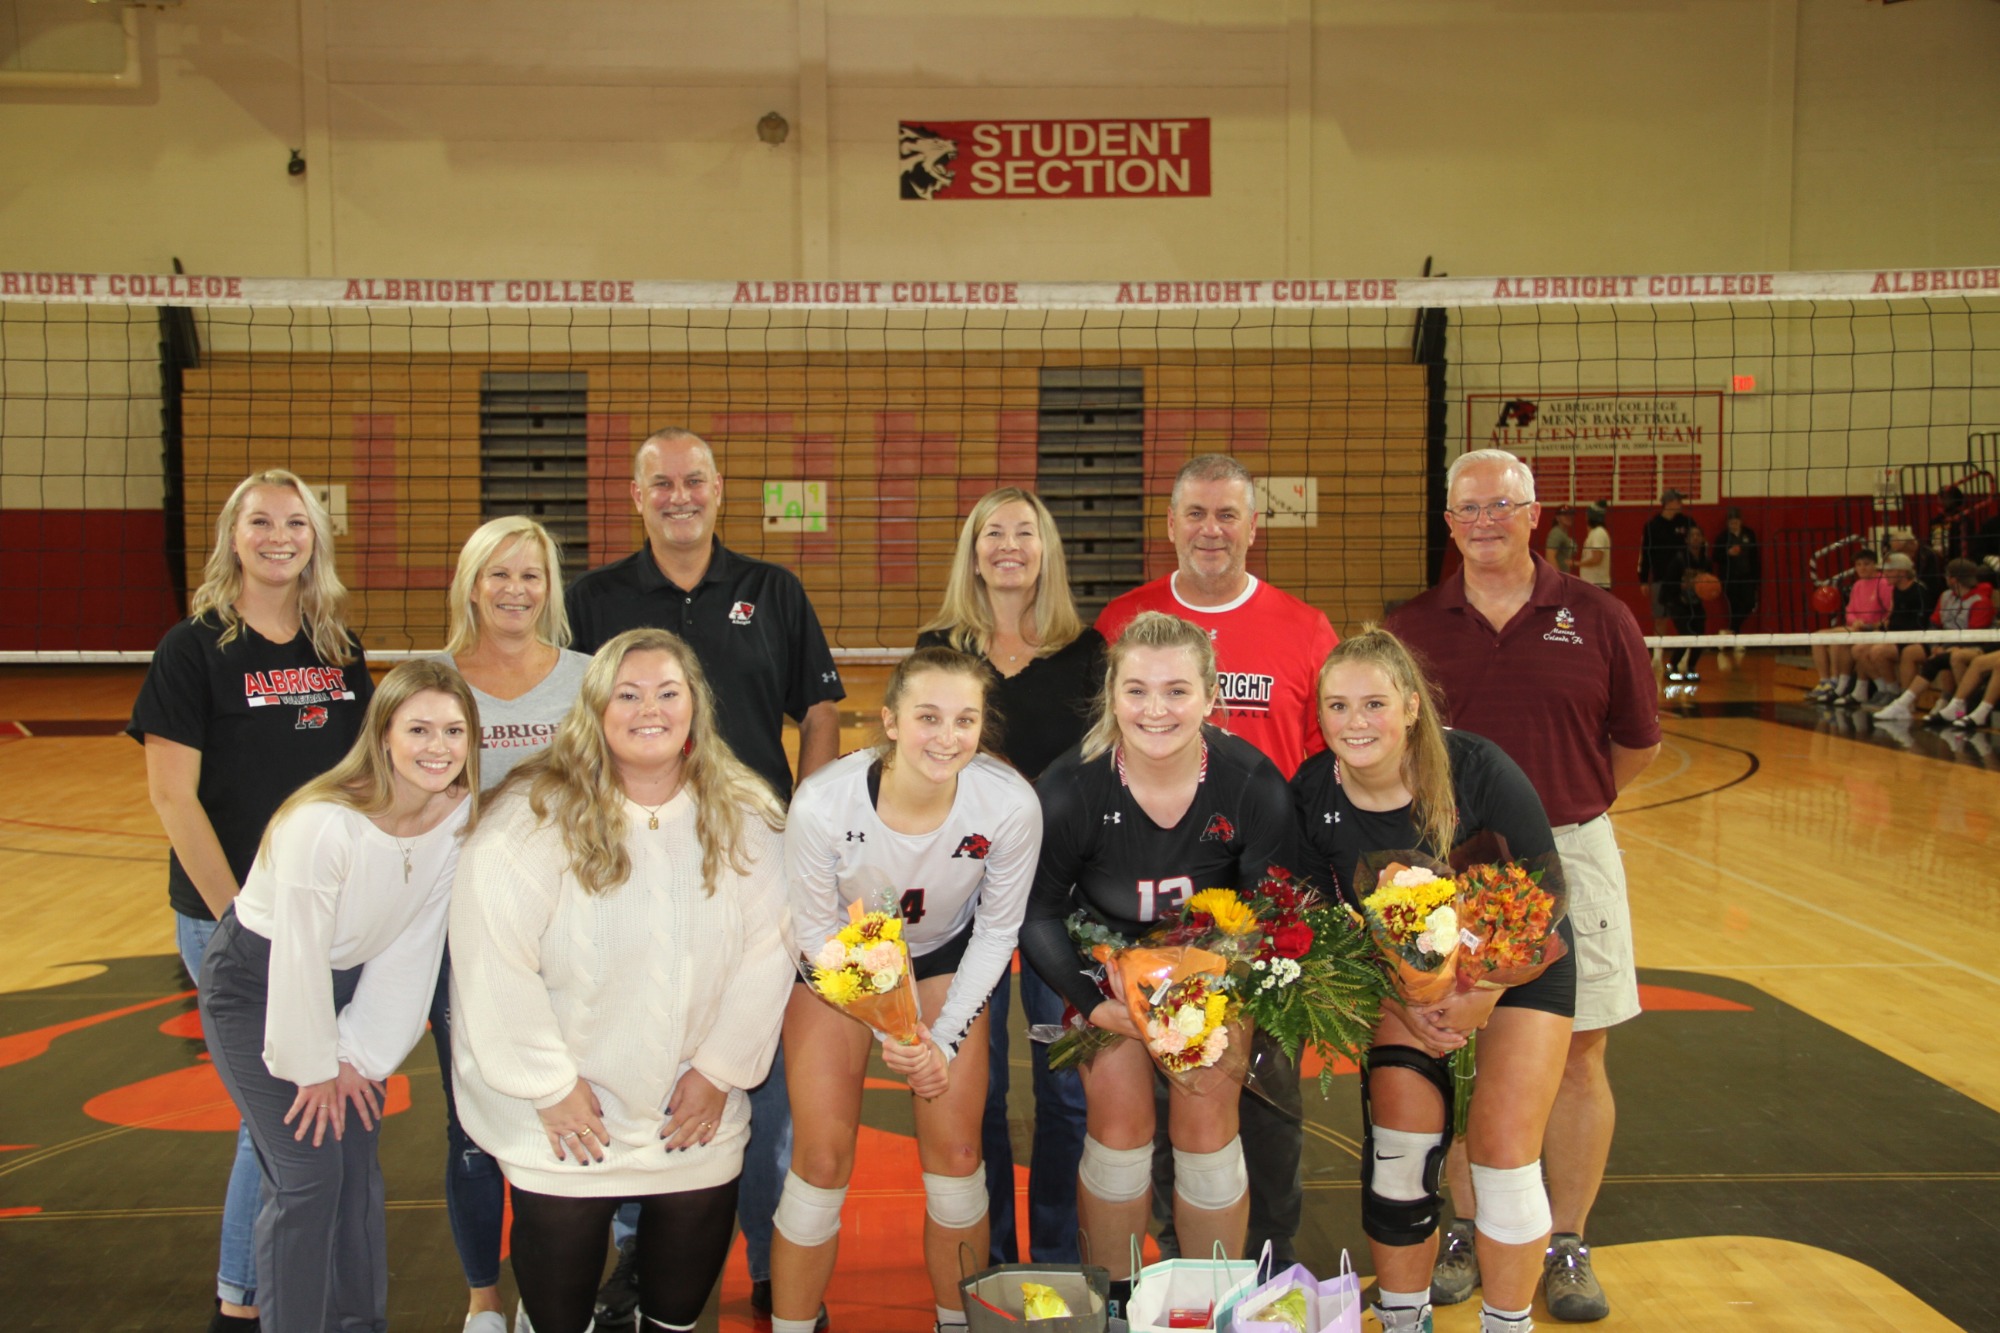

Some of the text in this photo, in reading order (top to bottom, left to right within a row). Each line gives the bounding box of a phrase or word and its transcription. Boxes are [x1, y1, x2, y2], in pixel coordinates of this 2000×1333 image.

[971, 122, 1190, 158] STUDENT
[969, 158, 1190, 195] SECTION
[1, 272, 242, 298] RIGHT COLLEGE
[343, 278, 634, 302] ALBRIGHT COLLEGE
[733, 281, 1018, 304] ALBRIGHT COLLEGE
[1115, 279, 1397, 303] ALBRIGHT COLLEGE
[1493, 274, 1774, 299] ALBRIGHT COLLEGE
[1870, 269, 2000, 293] ALBRIGH
[1541, 412, 1691, 426] MEN'S BASKETBALL
[1549, 401, 1678, 413] ALBRIGHT COLLEGE
[1488, 426, 1703, 448] ALL-CENTURY TEAM
[245, 666, 347, 696] ALBRIGHT
[1216, 671, 1274, 702] RIGHT
[480, 722, 561, 741] LBRIGH
[490, 735, 556, 749] VOLLEY
[896, 888, 926, 924] 4
